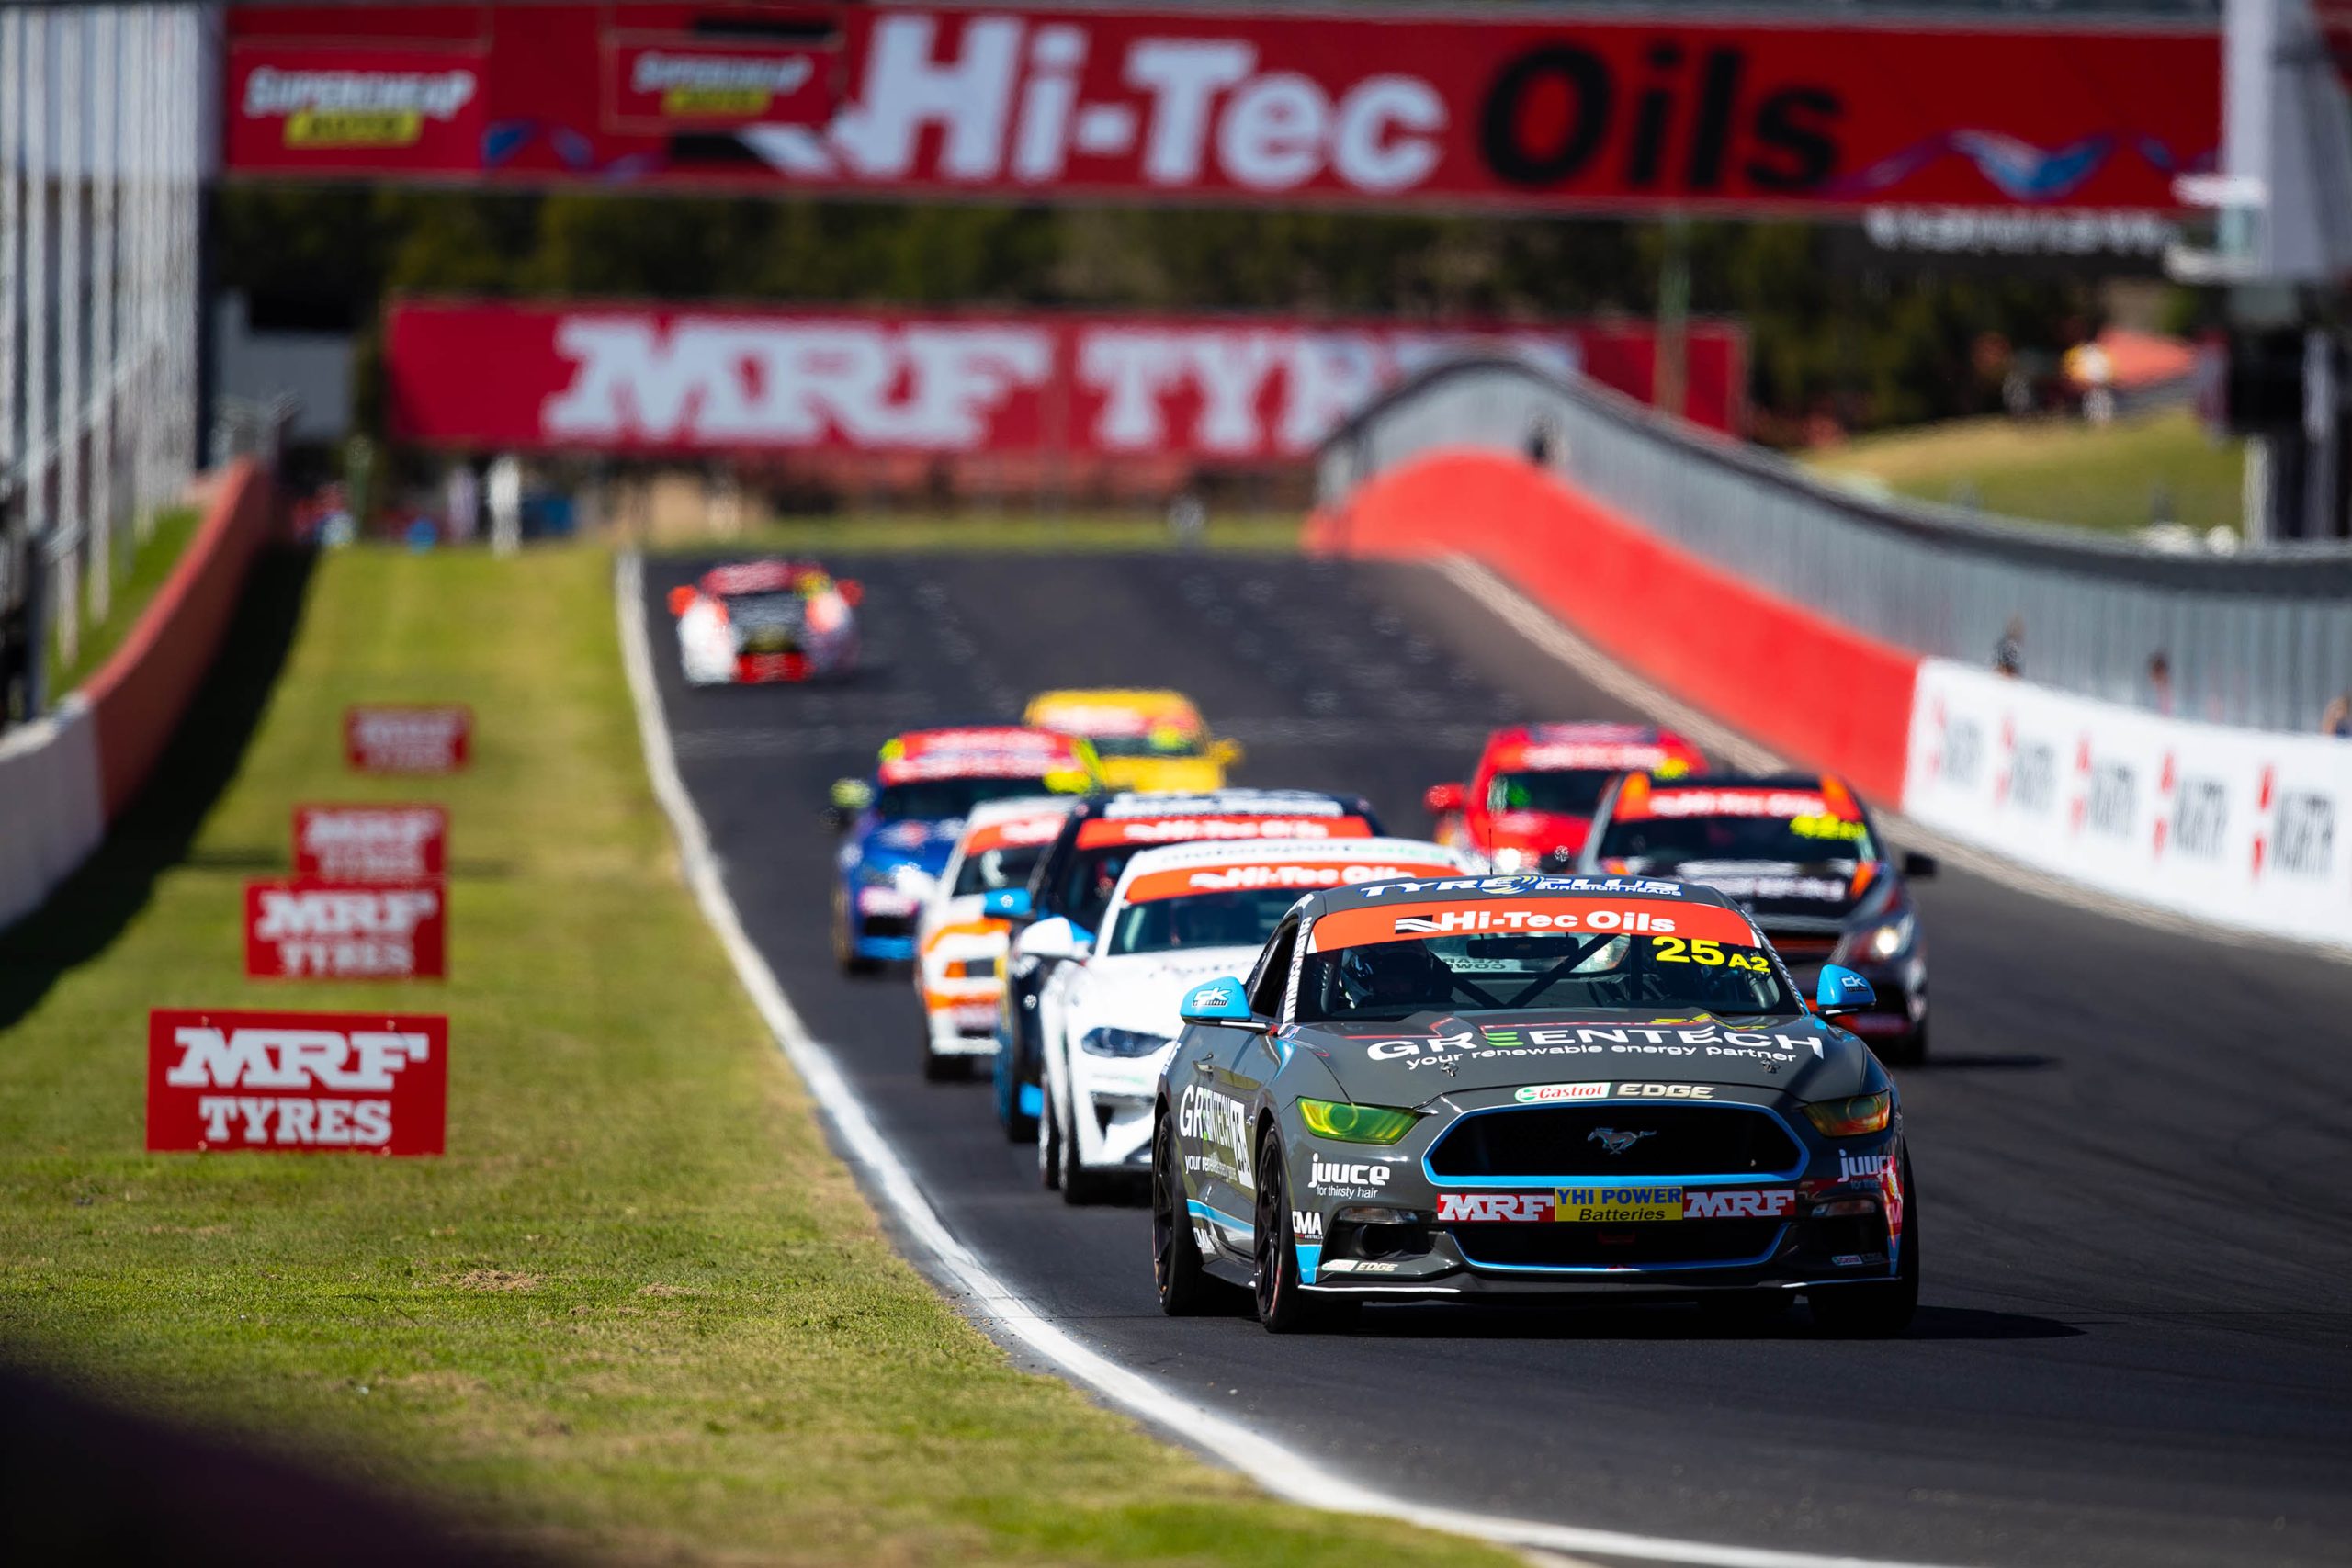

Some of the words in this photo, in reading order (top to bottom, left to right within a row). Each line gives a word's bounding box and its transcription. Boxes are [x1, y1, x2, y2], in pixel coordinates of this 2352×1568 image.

[862, 17, 1447, 189] Hi-Tec
[1479, 41, 1843, 195] Oils
[544, 317, 1053, 447] MRF
[1077, 327, 1582, 452] TYR
[1441, 910, 1578, 931] Hi-Tec
[1587, 910, 1676, 932] Oils
[1652, 935, 1725, 967] 25
[1728, 953, 1771, 974] A2
[1367, 1025, 1825, 1061] GREENTECH
[166, 1026, 430, 1092] MRF
[1406, 1052, 1463, 1070] your
[1471, 1045, 1603, 1059] renewable
[1611, 1045, 1698, 1056] energy
[1706, 1045, 1797, 1062] partner
[1539, 1085, 1603, 1100] Castrol
[1617, 1083, 1716, 1100] EDGE
[199, 1096, 392, 1146] TYRES
[1307, 1152, 1391, 1188] juuce
[1317, 1184, 1327, 1196] for
[1328, 1185, 1355, 1200] thirsty
[1357, 1186, 1379, 1199] hair
[1556, 1189, 1595, 1205] YHI
[1601, 1188, 1683, 1205] POWER
[1683, 1190, 1795, 1218] MRF
[1437, 1194, 1555, 1221] MRF
[1578, 1207, 1666, 1222] Batteries
[1356, 1262, 1399, 1272] EDGE
